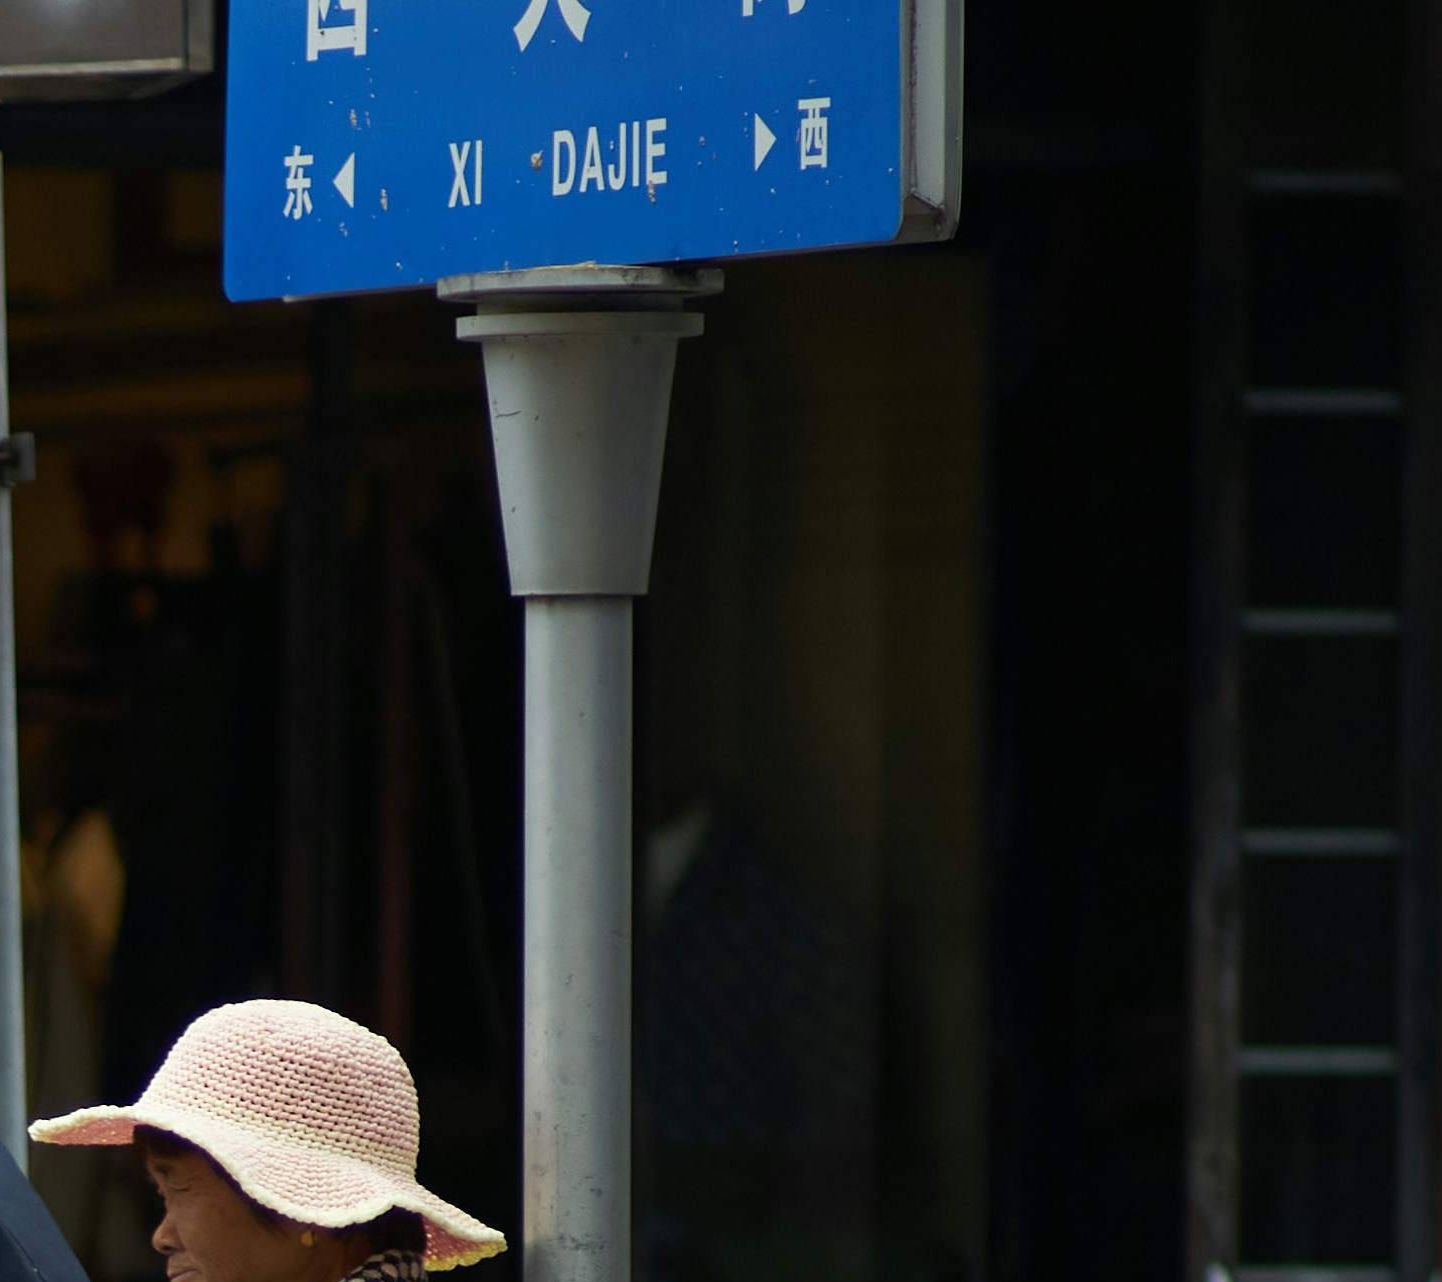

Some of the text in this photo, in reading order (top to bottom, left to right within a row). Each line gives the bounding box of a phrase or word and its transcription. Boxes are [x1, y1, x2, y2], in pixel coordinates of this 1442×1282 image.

[283, 97, 831, 220] 东 XI DAJIE 西
